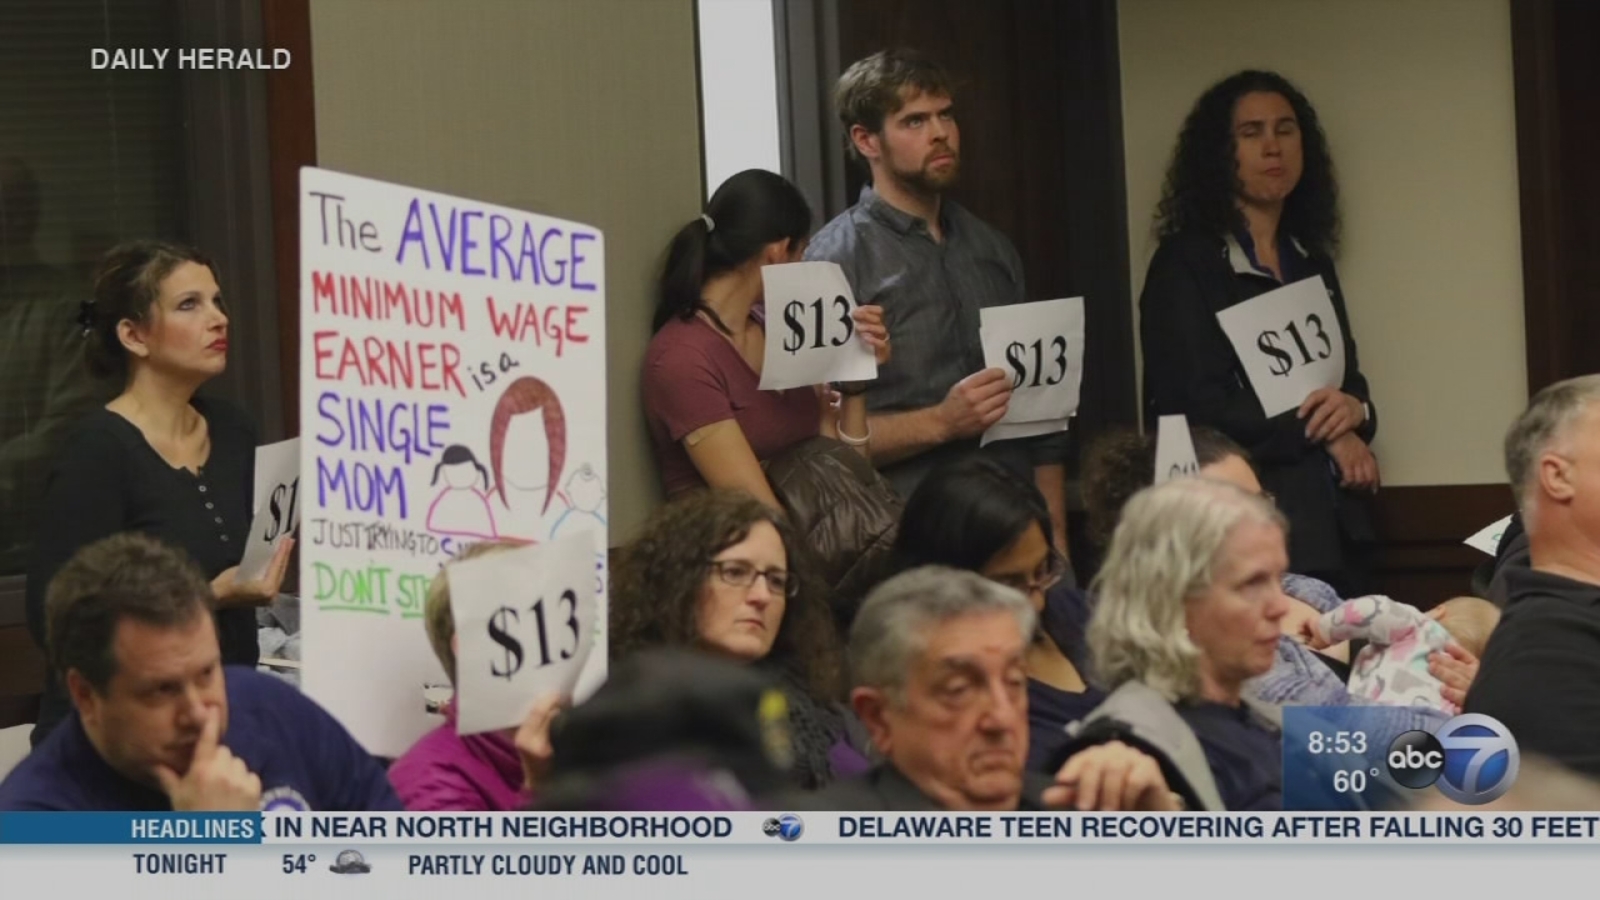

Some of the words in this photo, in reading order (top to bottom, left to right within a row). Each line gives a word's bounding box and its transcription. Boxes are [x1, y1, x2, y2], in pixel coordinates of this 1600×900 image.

[309, 191, 382, 253] The
[396, 197, 597, 291] AVERAGE
[311, 270, 465, 332] MINIMUM
[486, 296, 590, 358] WAGE
[783, 294, 853, 355] $13
[1256, 313, 1332, 377] $13
[313, 330, 467, 398] EARNER
[467, 361, 497, 392] is
[498, 352, 520, 373] a
[1004, 335, 1067, 390] $13
[316, 391, 450, 464] SINGLE
[264, 475, 300, 545] $1
[317, 456, 408, 519] MOM
[311, 518, 362, 549] JUST
[364, 521, 416, 556] TRYING
[488, 588, 581, 682] $13
